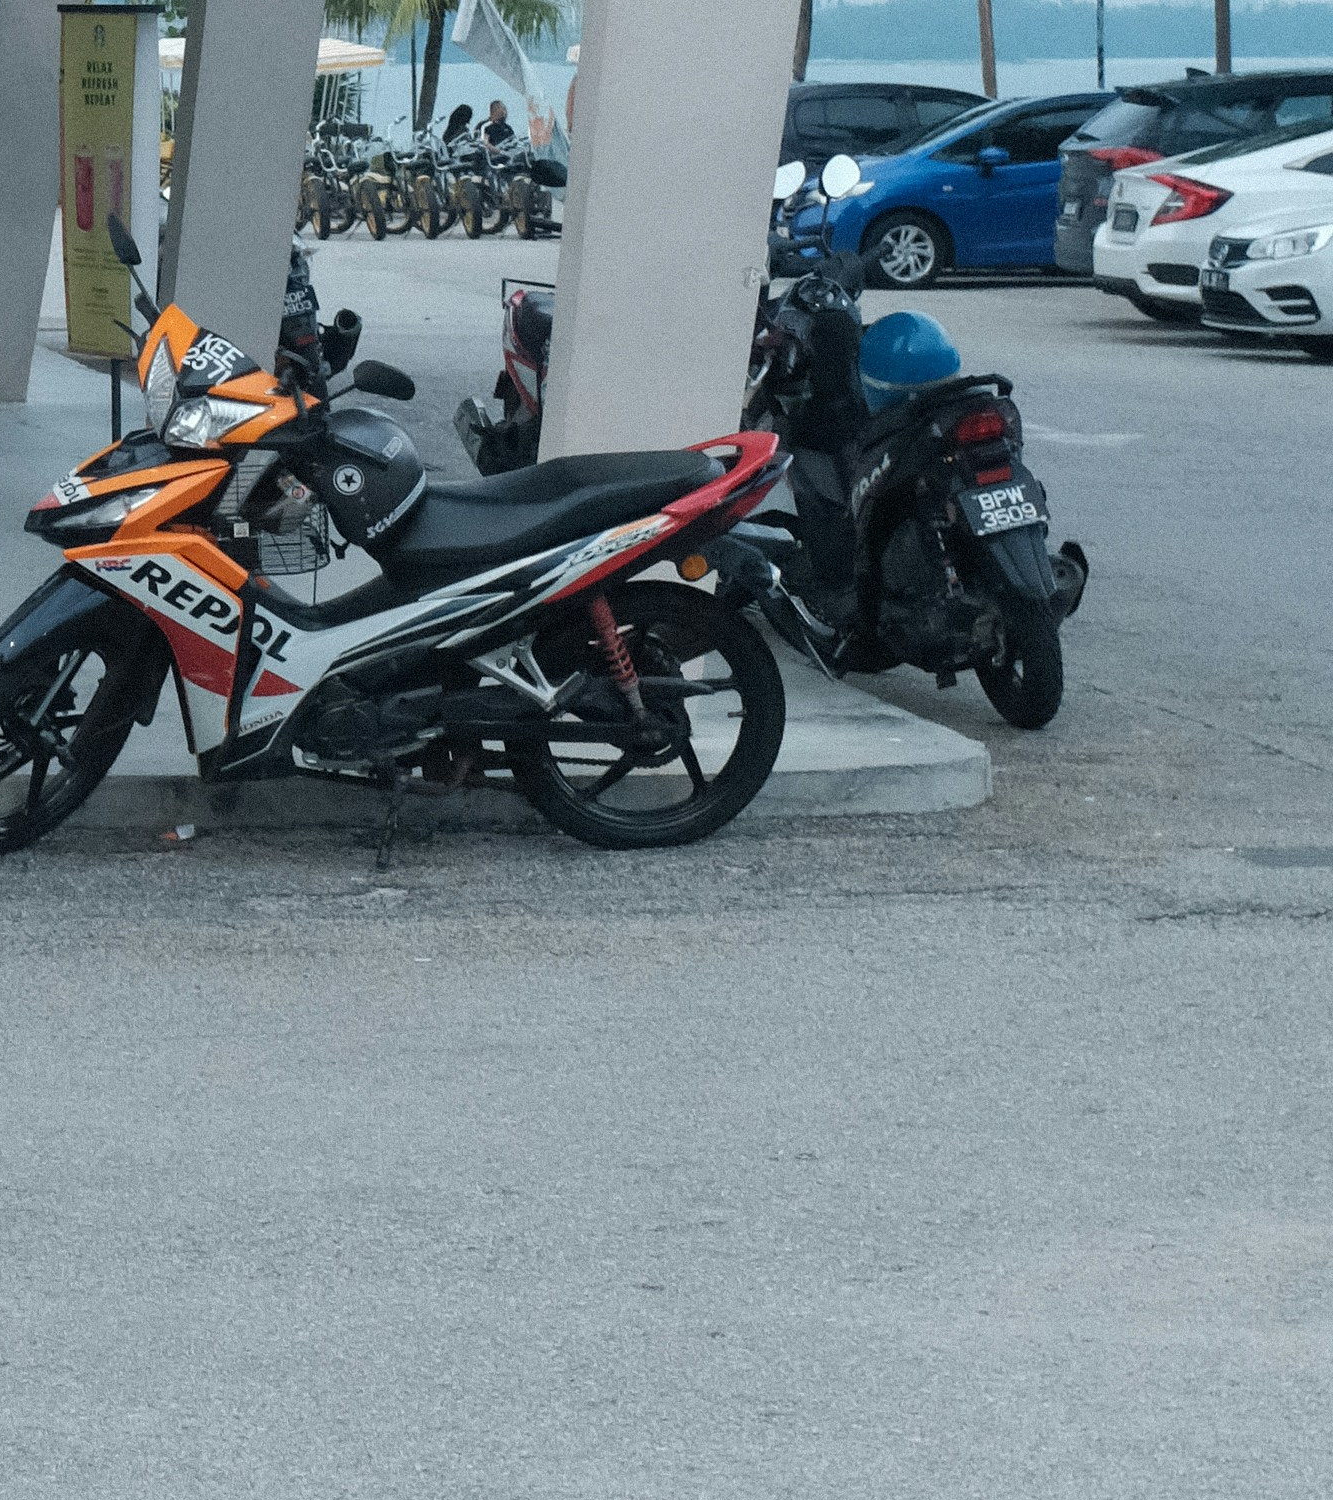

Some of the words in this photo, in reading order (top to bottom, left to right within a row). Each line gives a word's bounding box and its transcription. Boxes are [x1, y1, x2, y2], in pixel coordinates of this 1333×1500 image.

[86, 61, 113, 73] RELAX
[196, 333, 244, 369] KEE
[977, 486, 1024, 511] BPW
[981, 502, 1038, 528] 3509
